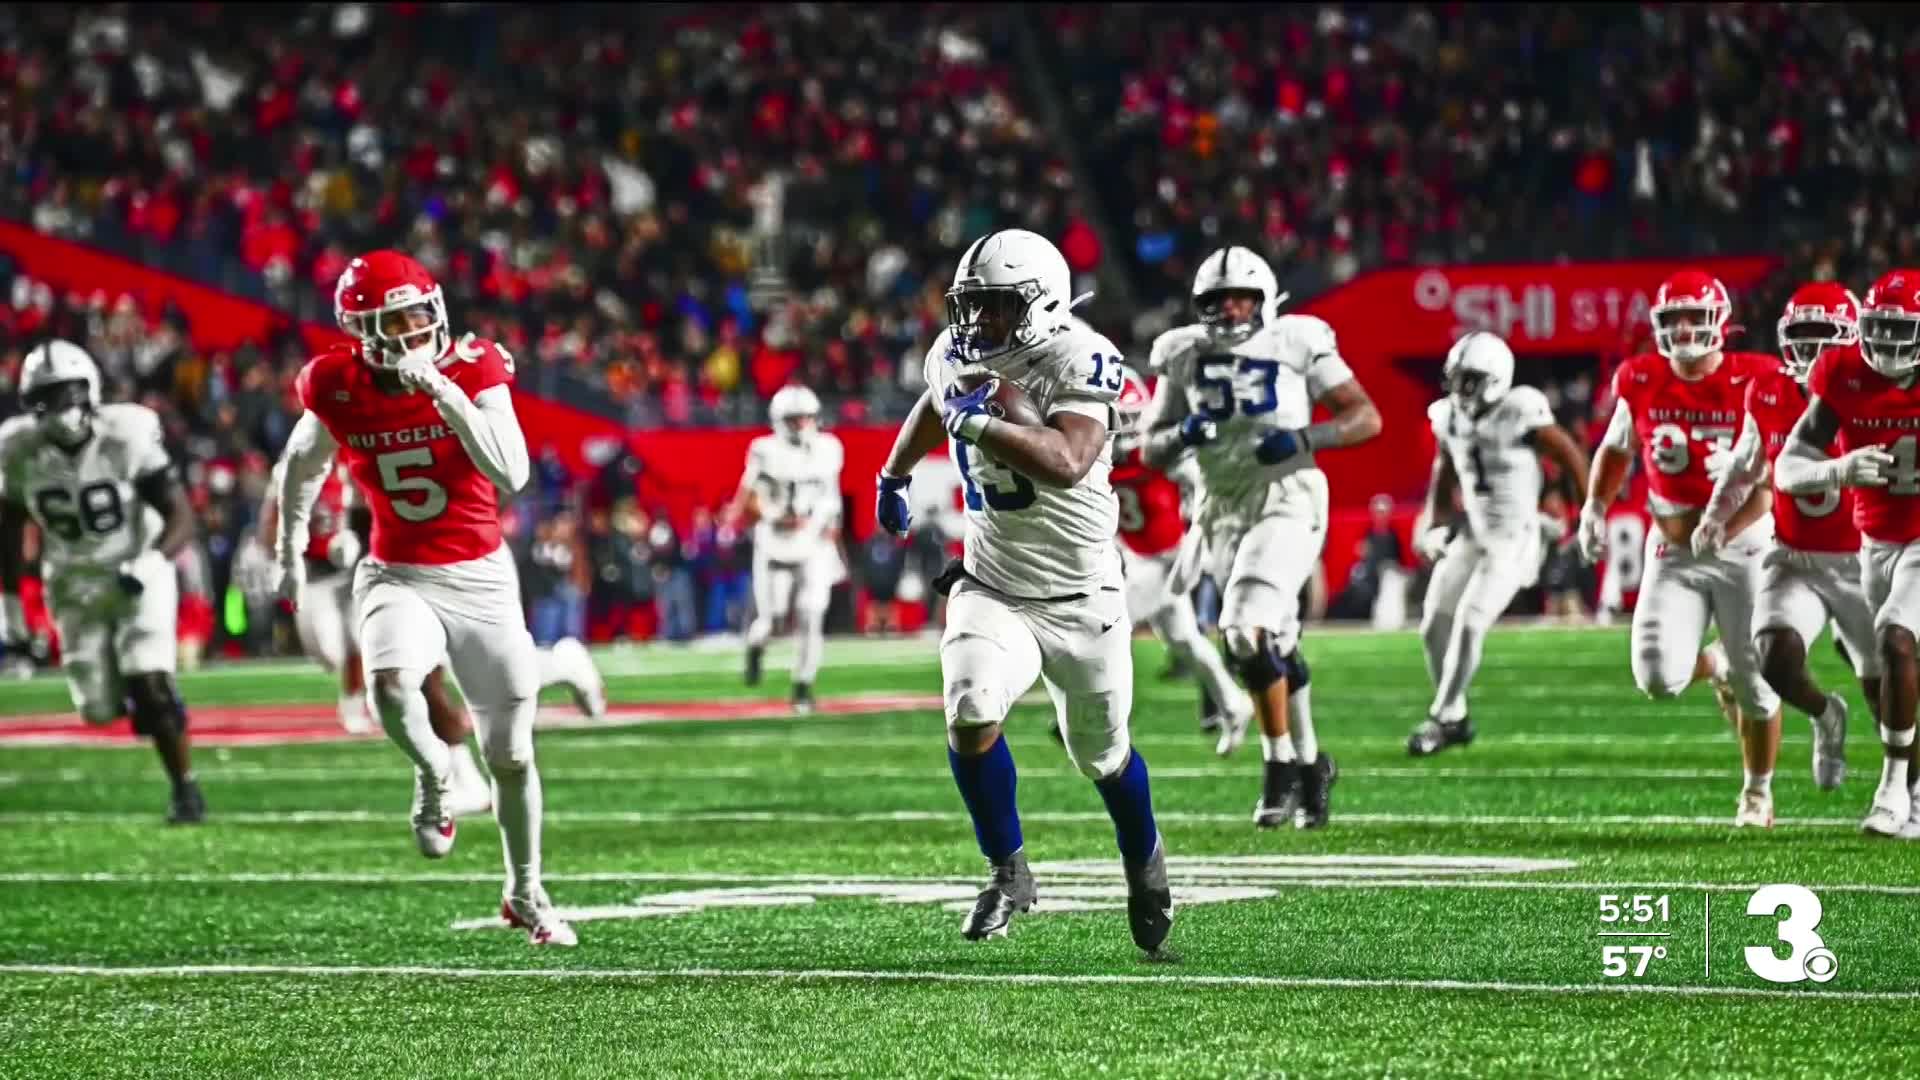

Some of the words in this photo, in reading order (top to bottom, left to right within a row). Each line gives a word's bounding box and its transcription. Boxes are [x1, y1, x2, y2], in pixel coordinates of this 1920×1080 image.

[1452, 283, 1556, 341] SHI
[1570, 287, 1652, 333] STA
[1087, 352, 1123, 392] 13
[1196, 355, 1279, 420] 53
[376, 446, 448, 523] 5
